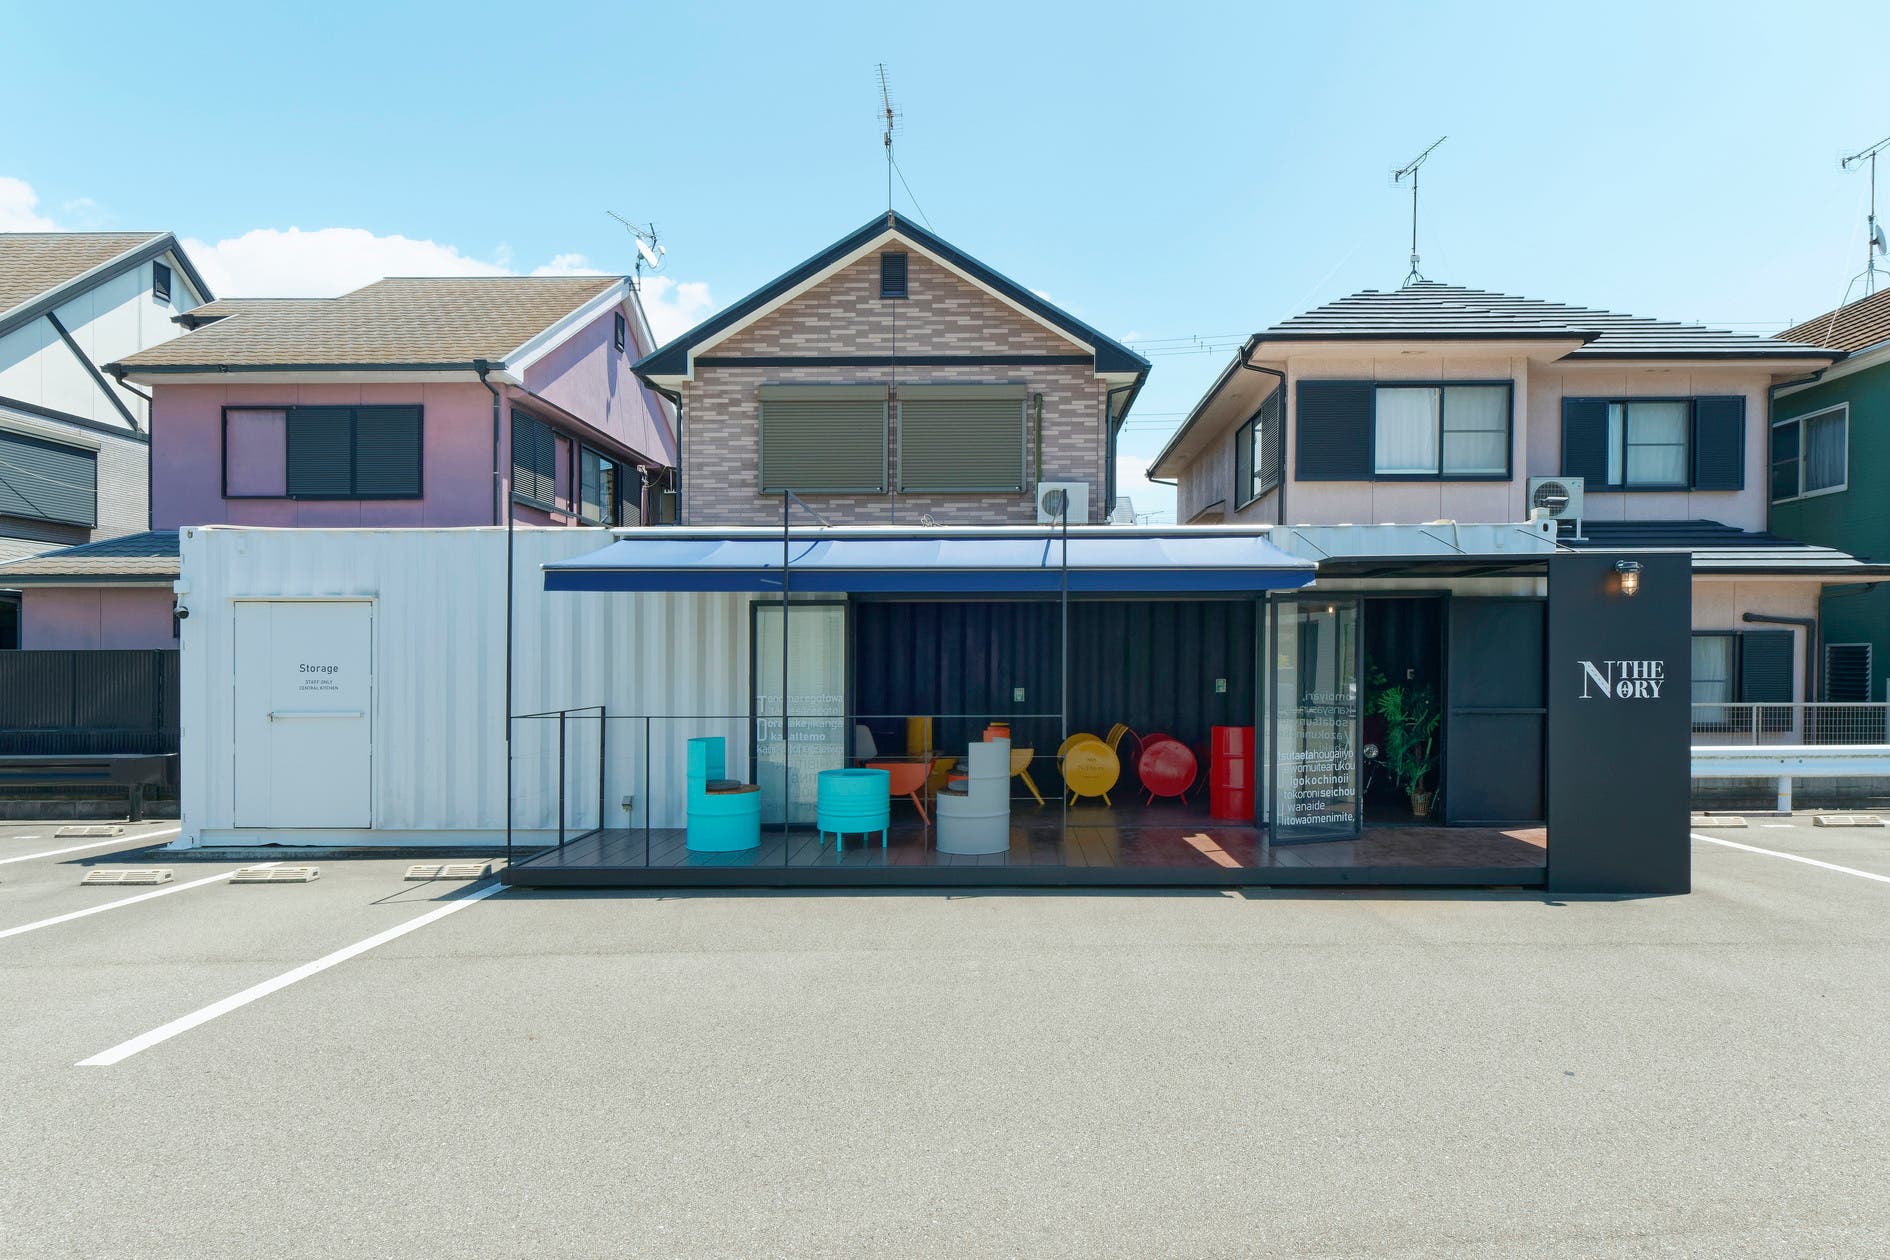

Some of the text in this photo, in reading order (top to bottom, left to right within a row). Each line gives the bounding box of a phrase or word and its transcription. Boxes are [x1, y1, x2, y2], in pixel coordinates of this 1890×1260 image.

[299, 663, 339, 675] Storage
[1616, 660, 1664, 679] THE
[1616, 680, 1664, 698] ORY
